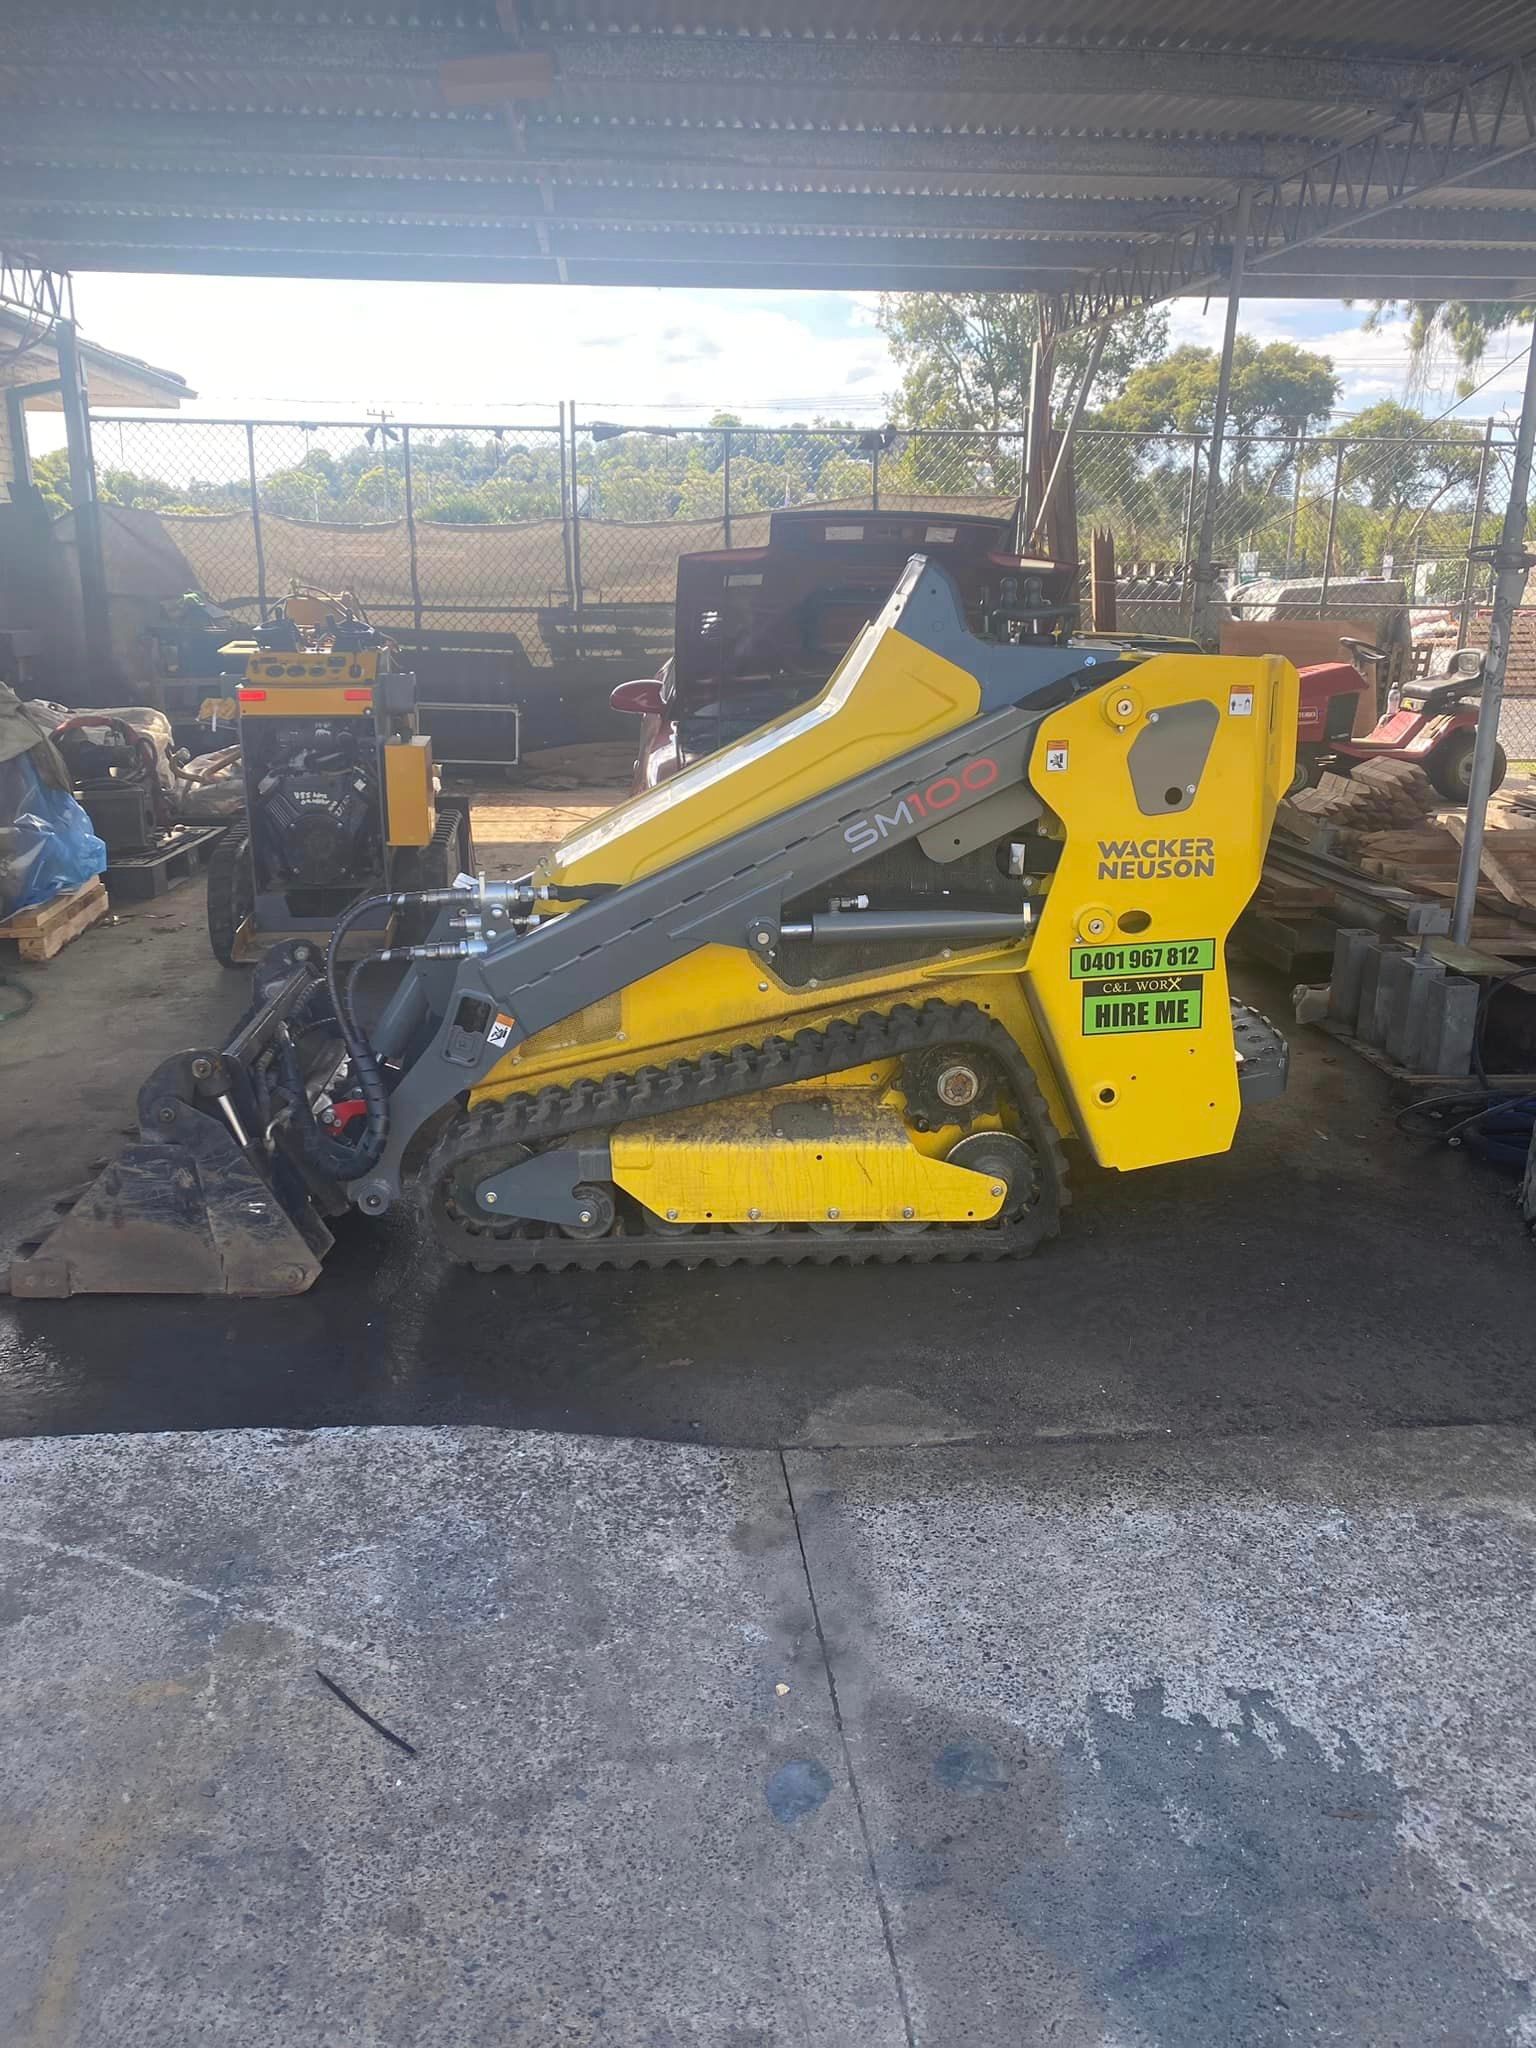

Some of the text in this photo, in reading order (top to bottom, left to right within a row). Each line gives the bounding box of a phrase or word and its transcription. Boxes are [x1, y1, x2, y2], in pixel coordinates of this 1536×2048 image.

[844, 757, 998, 854] SM100
[1097, 838, 1215, 859] WACKER
[1098, 858, 1215, 880] NEUSON
[1080, 946, 1199, 972] 0401 967 812
[1103, 981, 1132, 993] C&L
[1095, 999, 1189, 1028] HIRE ME
